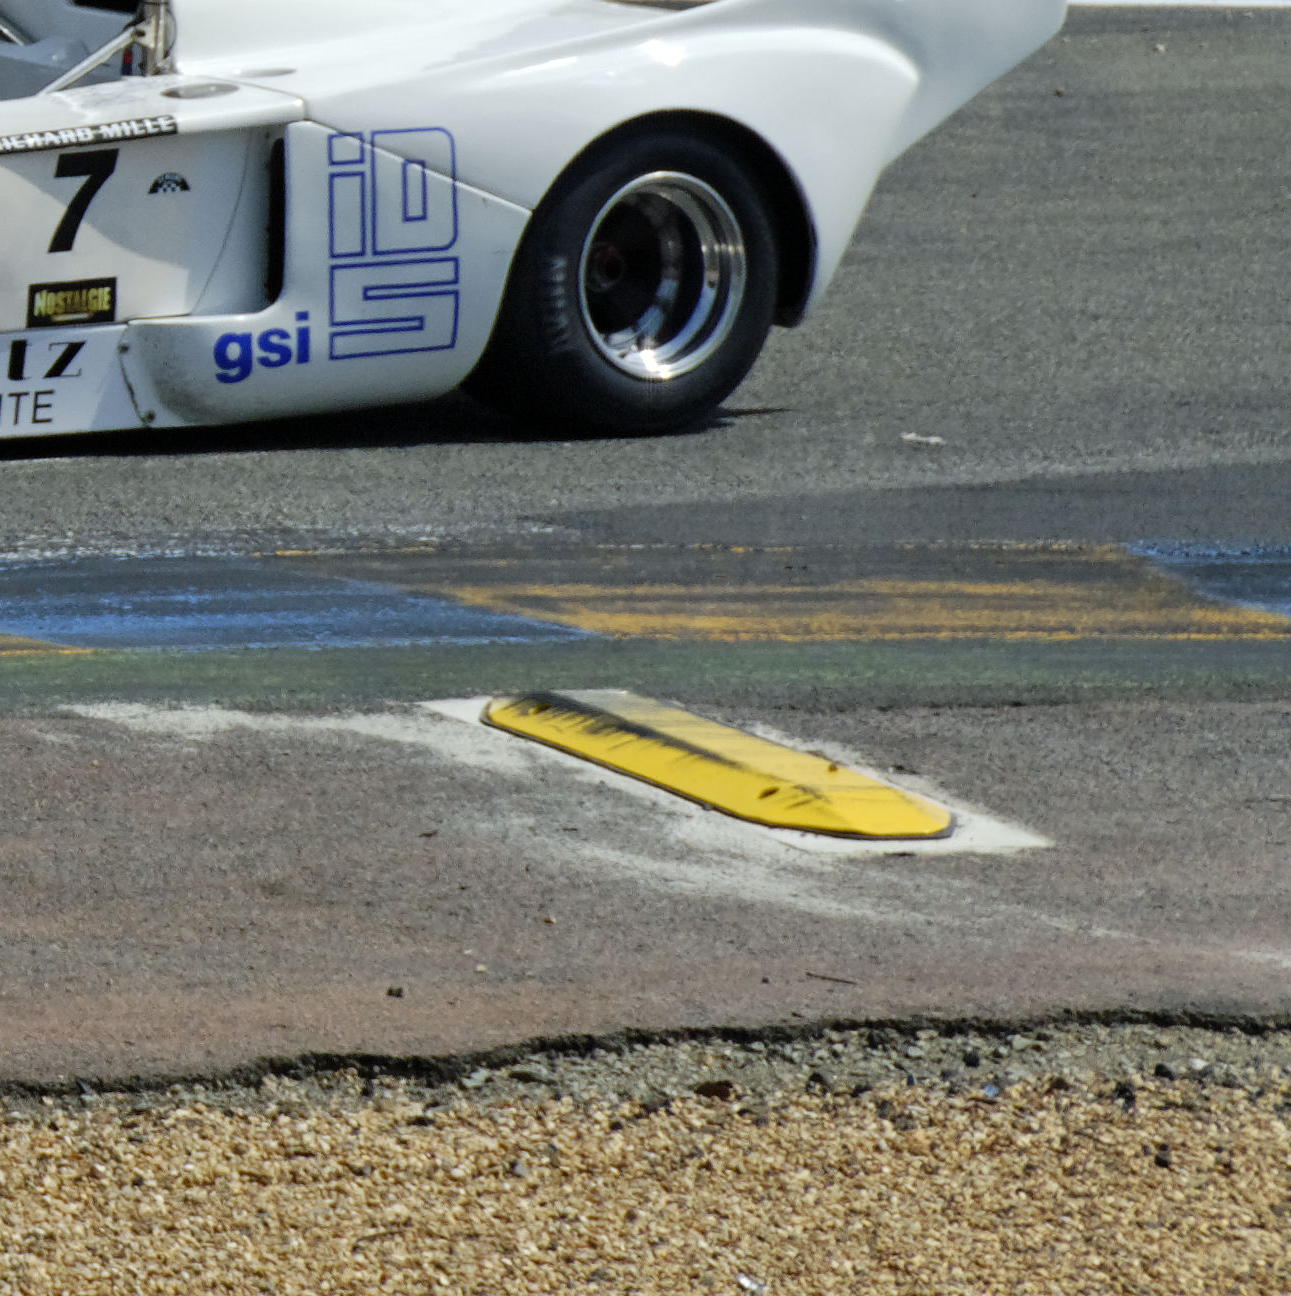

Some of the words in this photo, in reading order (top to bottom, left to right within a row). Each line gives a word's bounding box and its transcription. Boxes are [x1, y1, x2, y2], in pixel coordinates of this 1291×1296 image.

[98, 115, 177, 139] MILLE
[47, 148, 119, 253] 7
[34, 287, 111, 317] NOSTALGIE
[214, 310, 311, 384] gsi
